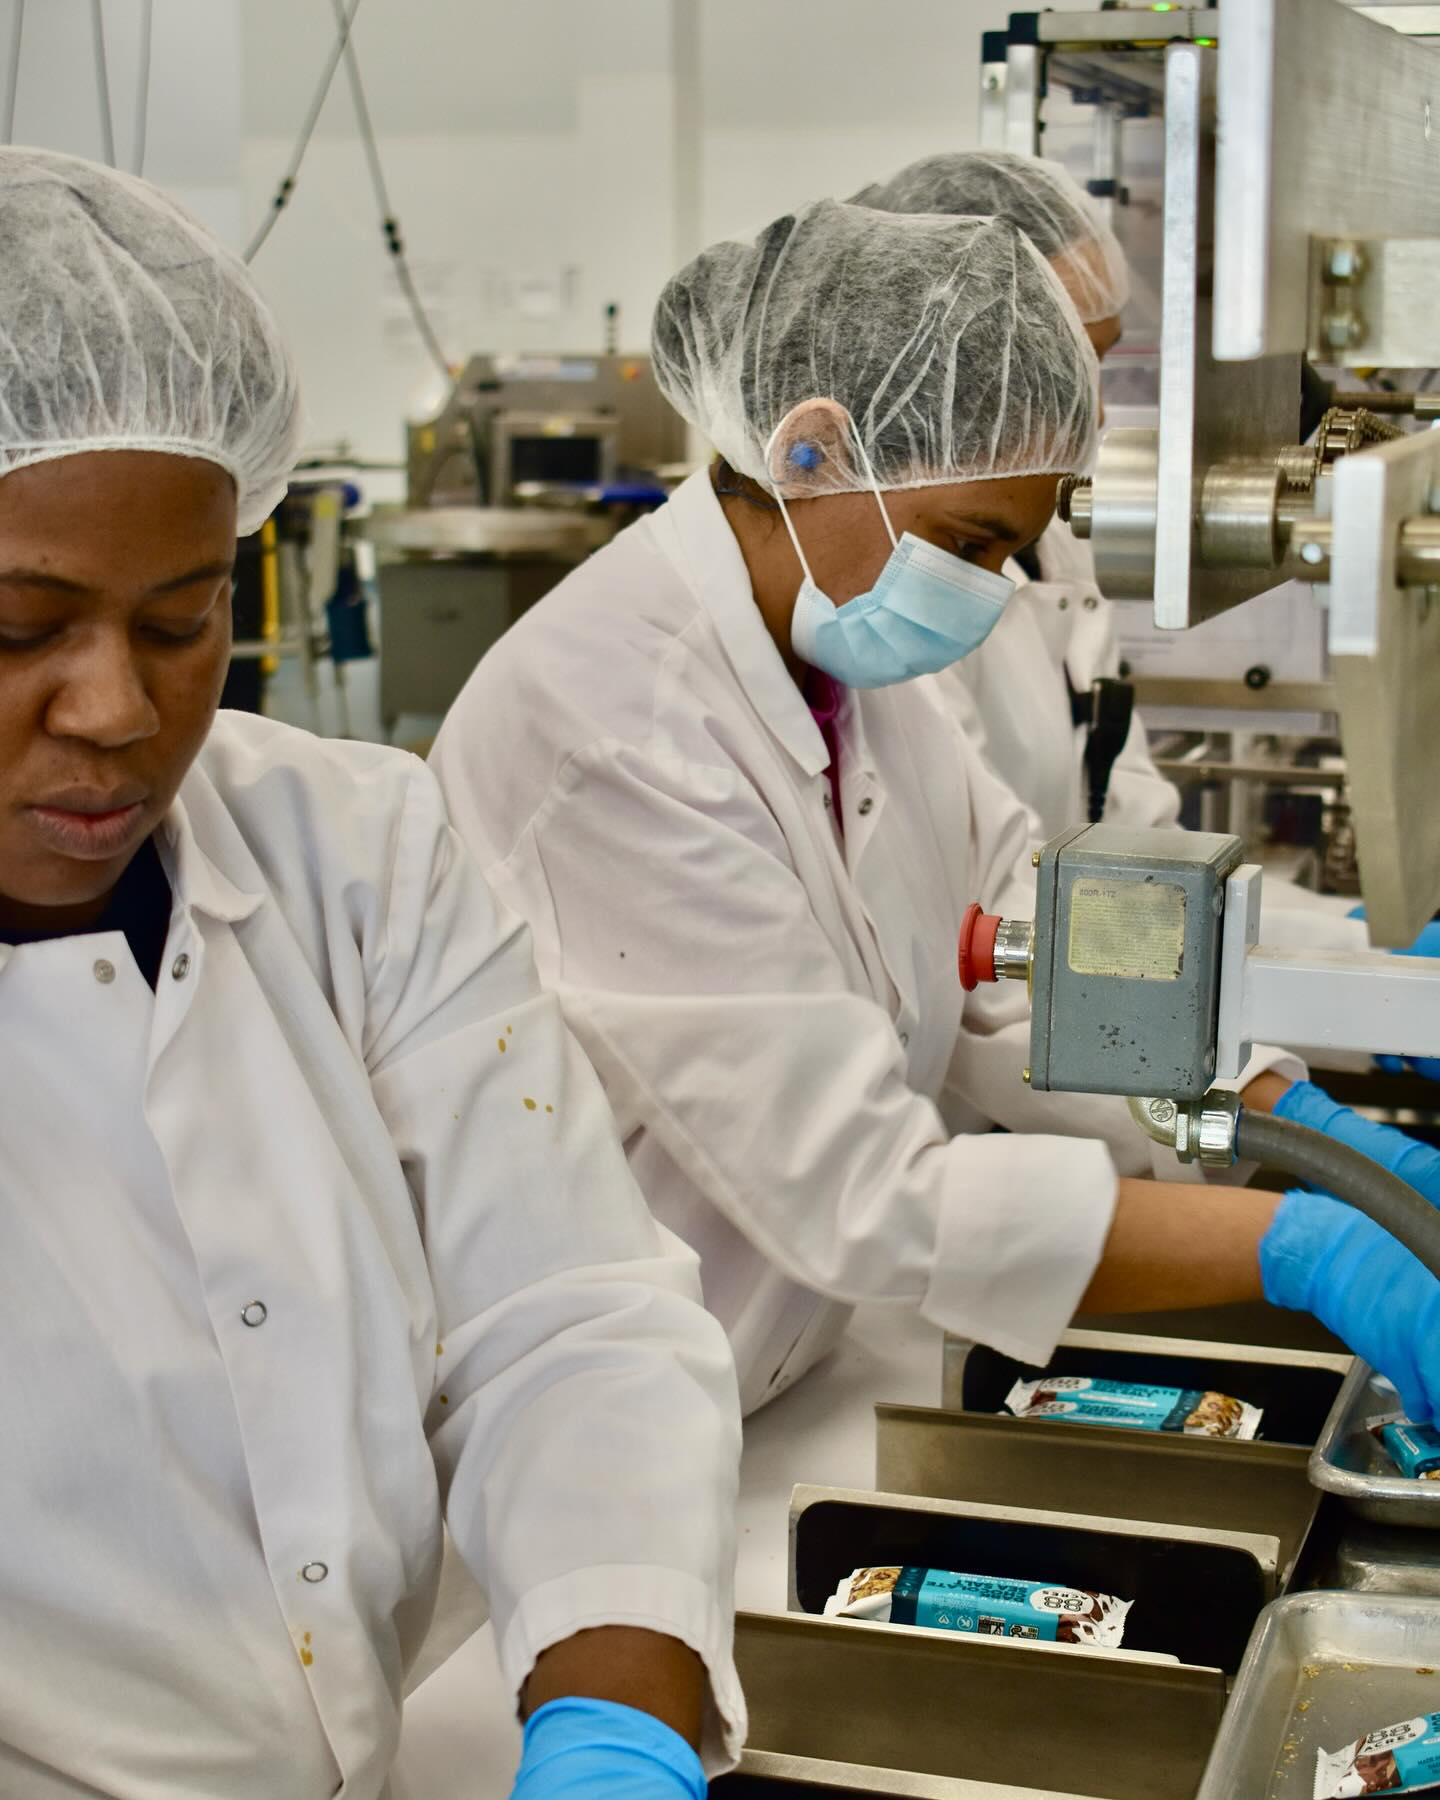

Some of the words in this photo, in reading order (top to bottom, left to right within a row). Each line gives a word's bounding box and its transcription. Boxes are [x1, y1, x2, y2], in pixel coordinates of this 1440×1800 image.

[927, 1580, 1026, 1598] CHOCOLATE
[956, 1579, 994, 1589] SALT
[998, 1584, 1028, 1593] SEA
[980, 1591, 1025, 1603] DARK
[1042, 1590, 1088, 1600] ACRES
[1043, 1596, 1083, 1612] 88
[1367, 1724, 1411, 1743] 88
[1364, 1733, 1417, 1752] ACRES
